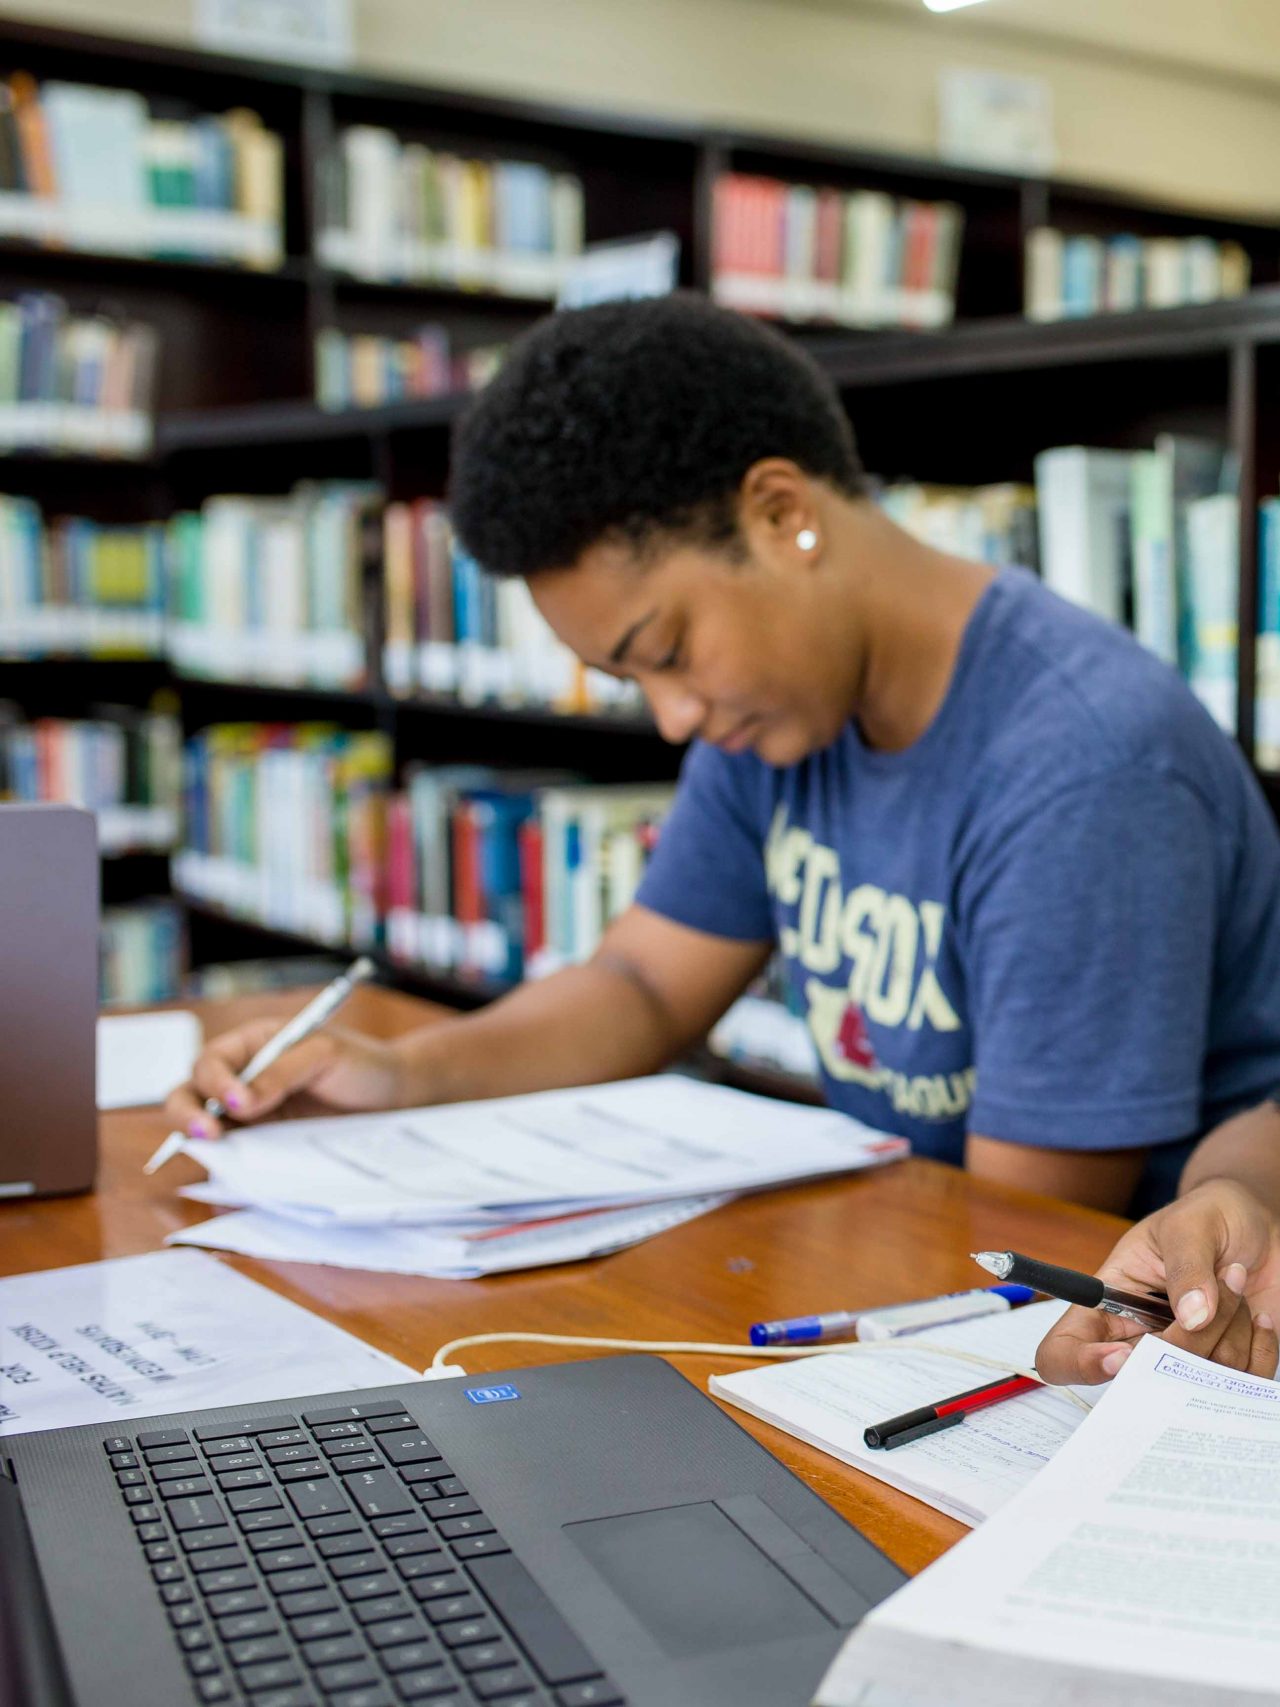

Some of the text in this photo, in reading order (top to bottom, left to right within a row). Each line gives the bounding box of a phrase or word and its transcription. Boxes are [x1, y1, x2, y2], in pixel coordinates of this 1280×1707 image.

[1162, 1365, 1279, 1401] DERRICK LEARNING
[1171, 1361, 1276, 1395] SUPPORT CENTRE
